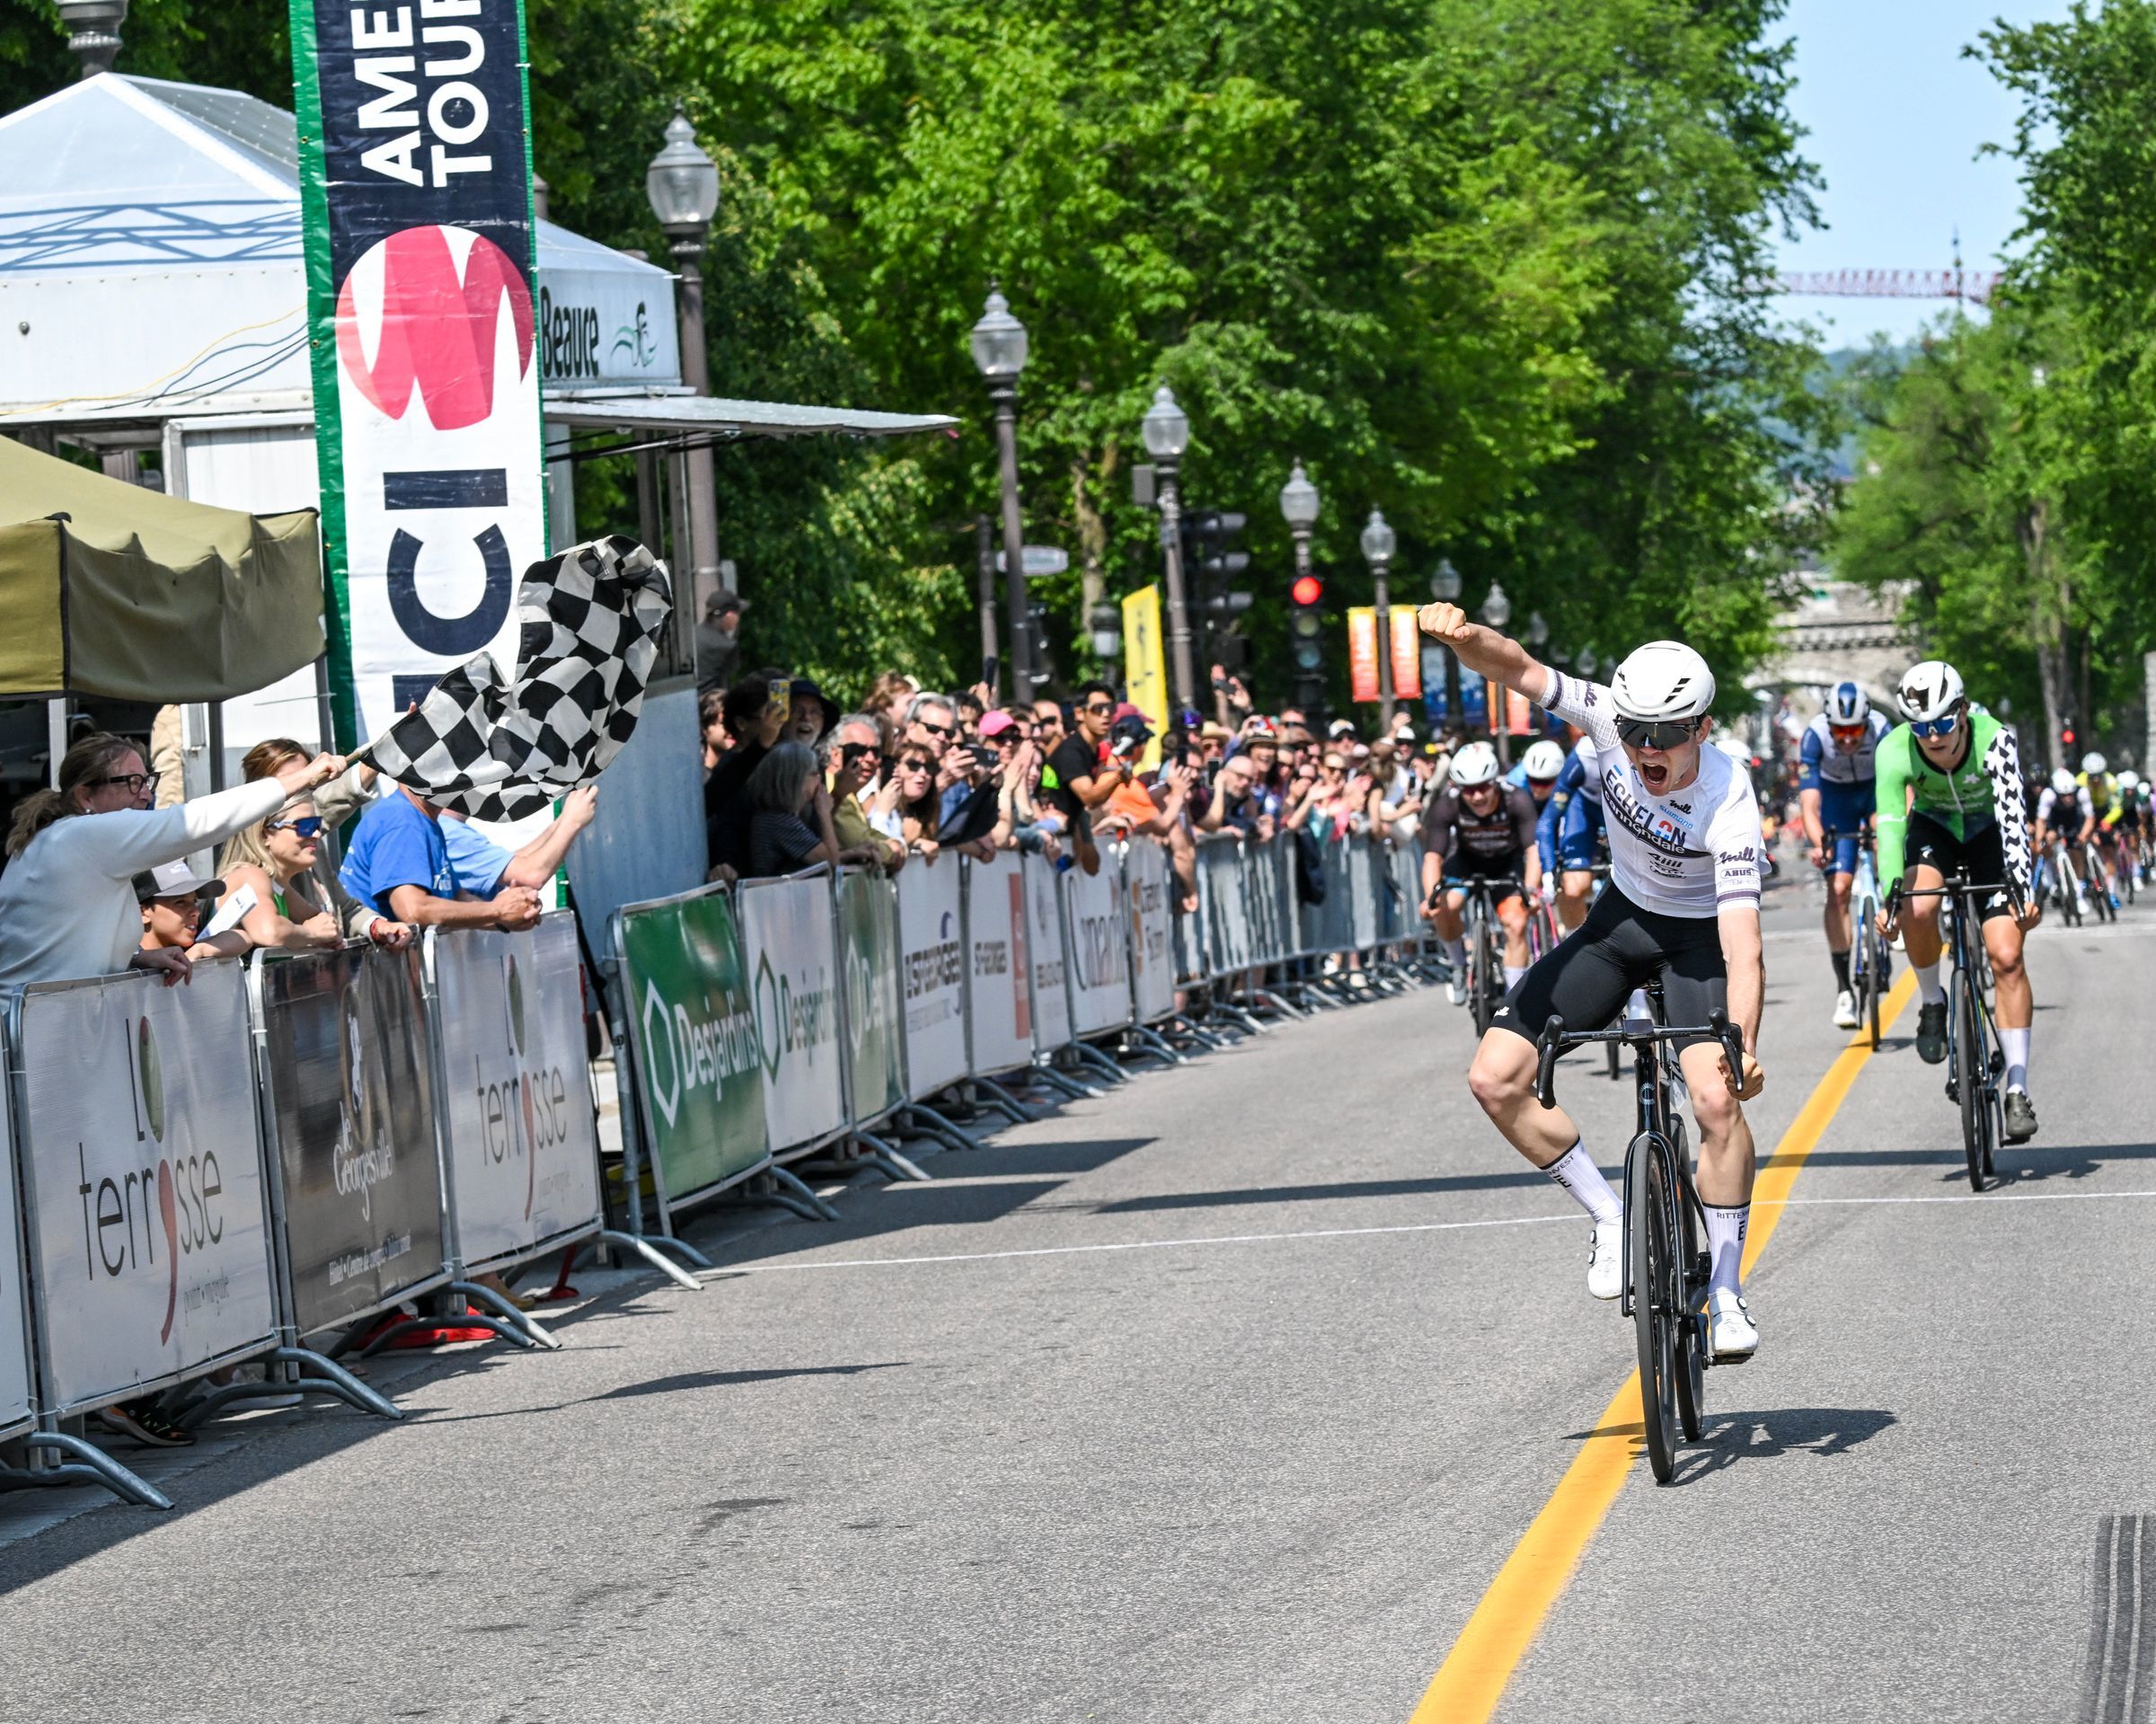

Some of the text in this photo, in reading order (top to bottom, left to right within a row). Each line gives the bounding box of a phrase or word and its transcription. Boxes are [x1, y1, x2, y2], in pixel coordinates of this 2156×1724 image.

[350, 0, 424, 188] AME
[1724, 869, 1752, 878] ABUS
[674, 990, 762, 1101] Desjardins
[332, 1127, 393, 1223] Georgesville
